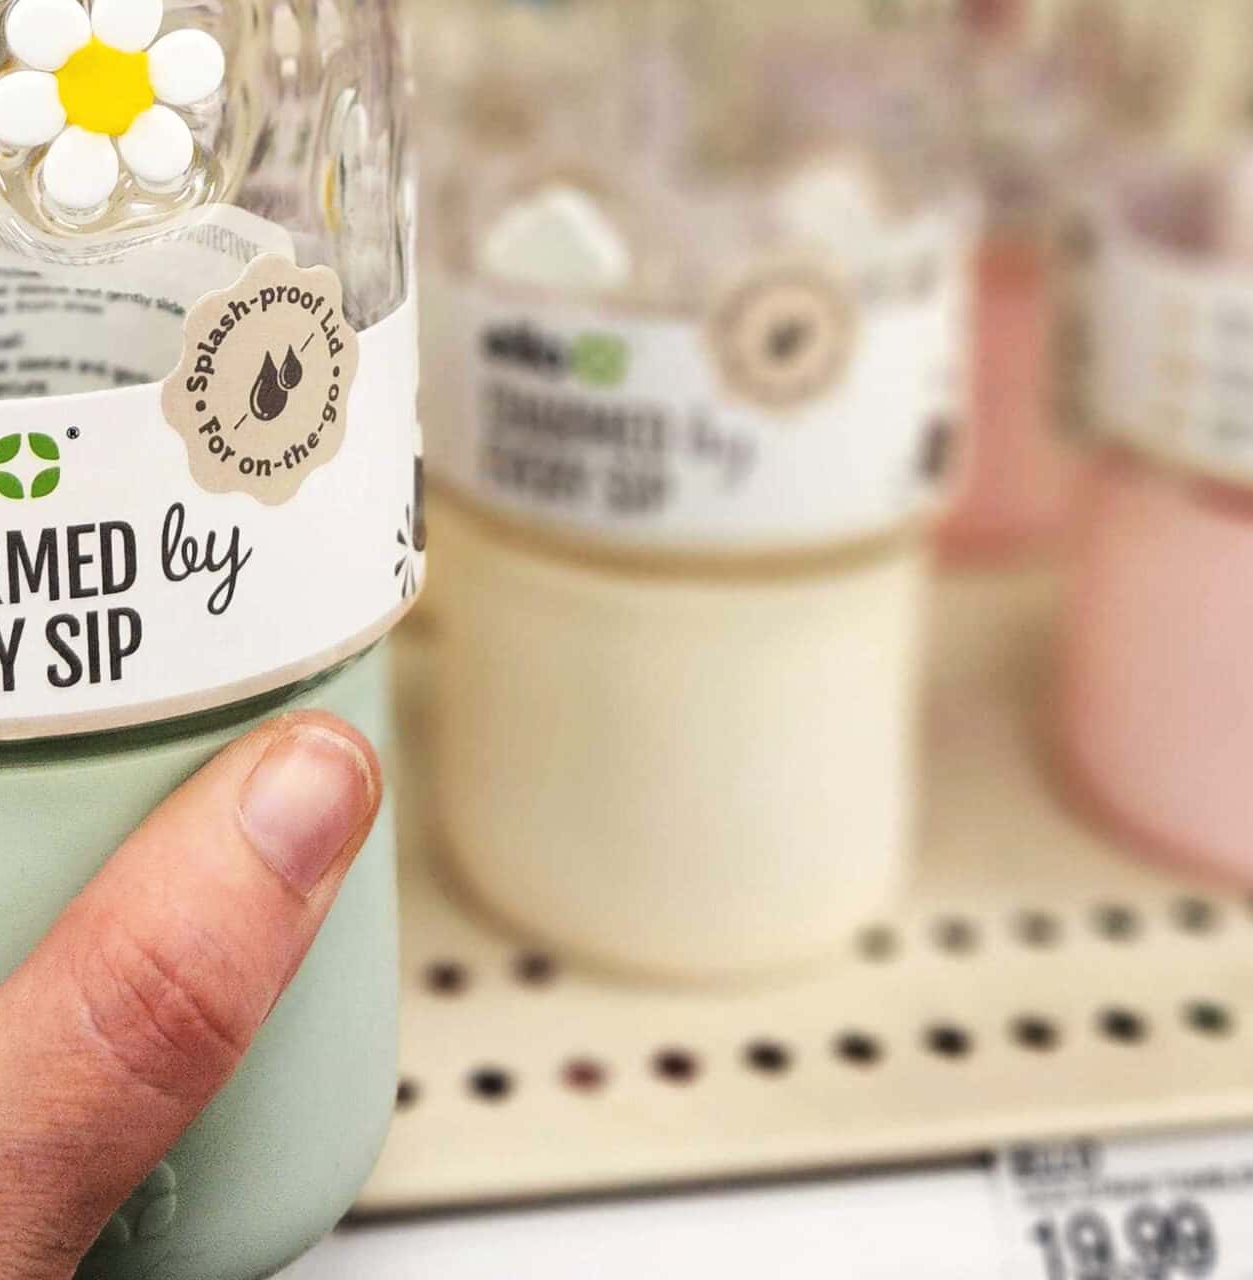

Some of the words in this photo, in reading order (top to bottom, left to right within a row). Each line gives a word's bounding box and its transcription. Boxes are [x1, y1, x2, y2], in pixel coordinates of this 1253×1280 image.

[186, 285, 325, 393] Splash-proof
[319, 308, 344, 359] Lid
[198, 416, 237, 463] For
[238, 383, 340, 477] on-the-go
[161, 501, 254, 616] by
[44, 607, 143, 689] SIP
